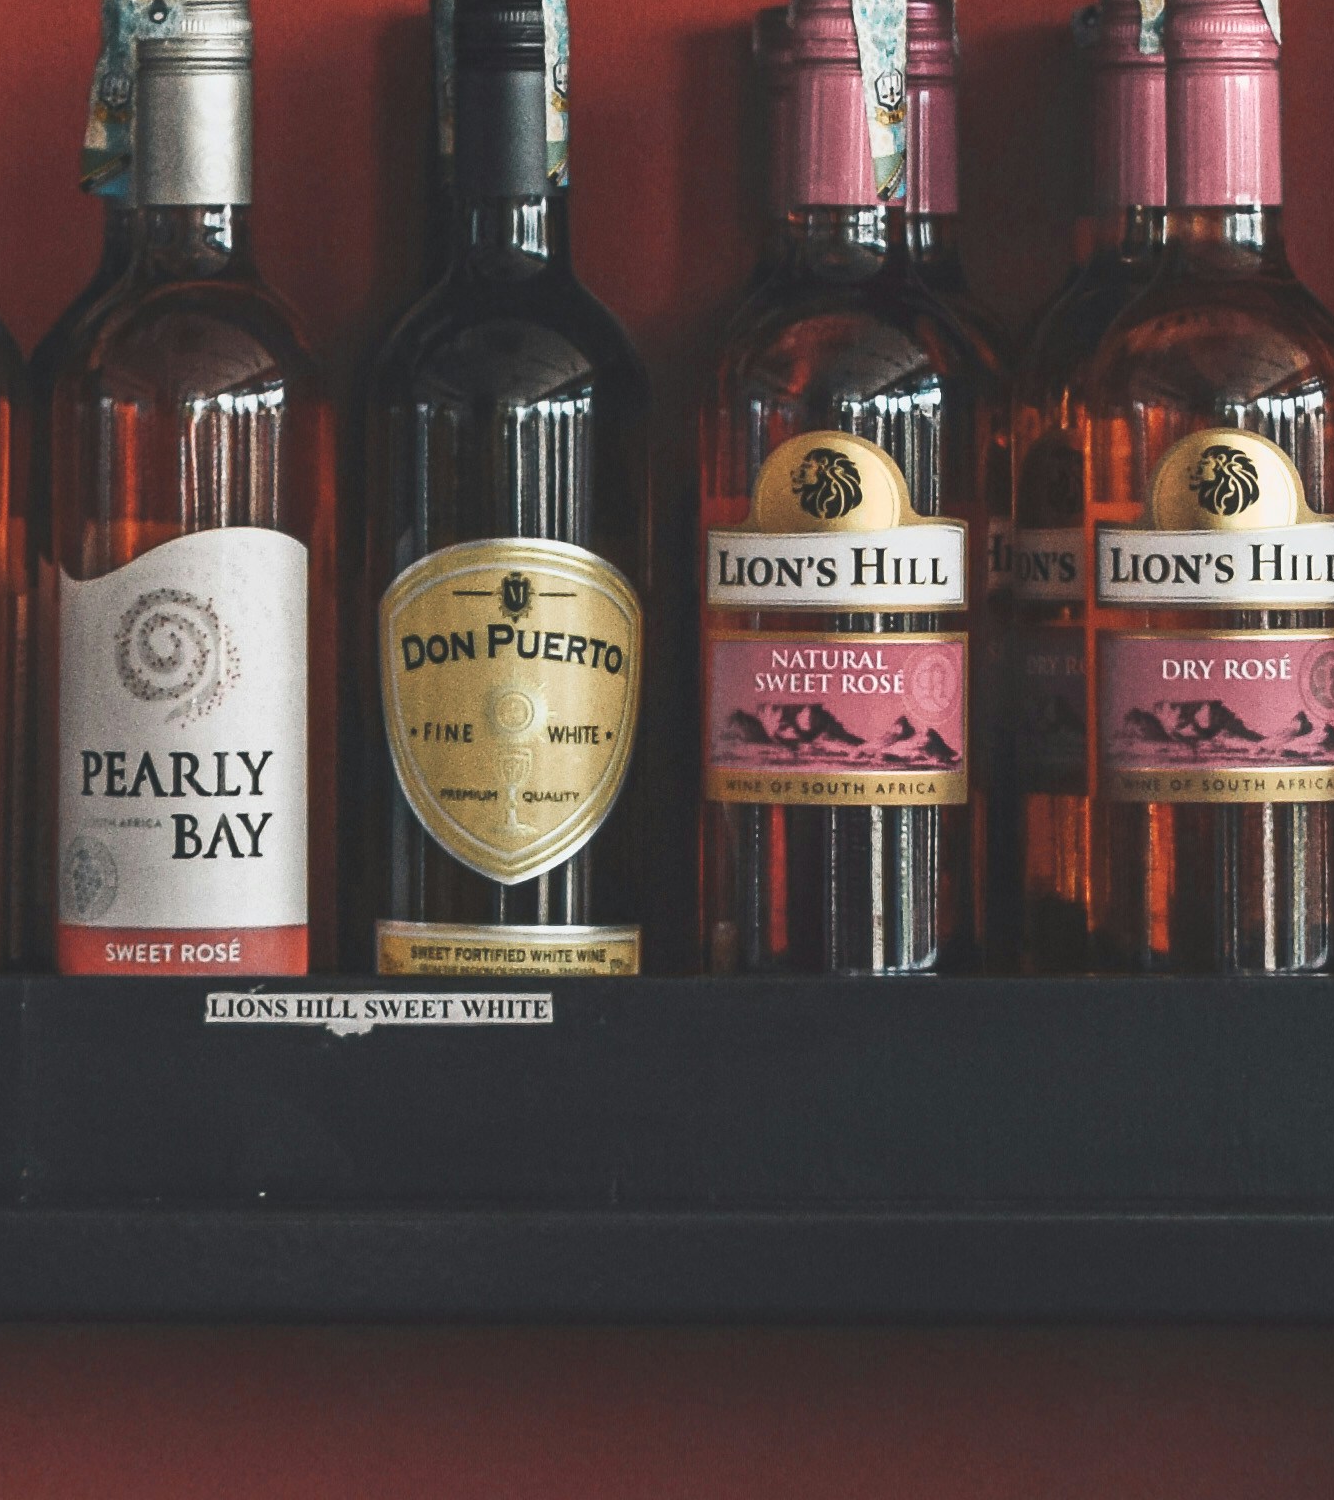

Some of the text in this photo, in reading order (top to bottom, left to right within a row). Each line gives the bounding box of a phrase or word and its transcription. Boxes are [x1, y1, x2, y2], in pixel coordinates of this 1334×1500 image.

[718, 547, 948, 587] LION'S HILL
[1110, 546, 1235, 584] LION'S
[401, 623, 624, 675] DON PUERTO
[771, 649, 888, 669] NATURAL
[1162, 653, 1292, 680] DRY ROSÉ
[755, 668, 904, 694] SWEET ROSÉ
[423, 722, 600, 745] FINE WHITE
[80, 750, 274, 797] PEARLY
[1171, 778, 1192, 791] OF
[1202, 779, 1266, 792] SOUTH
[1276, 778, 1334, 791] AFRICA
[440, 790, 580, 803] PREMIUM QUALITY
[771, 780, 792, 793] OF
[802, 781, 865, 795] SOUTH
[875, 780, 937, 794] AFRICA
[171, 813, 273, 859] BAY
[105, 937, 241, 962] SWEET ROSÉ
[410, 945, 607, 963] SWEET FORTIFIED WHITE WINE
[210, 998, 548, 1019] LIONS HILL SWEET WHITE
